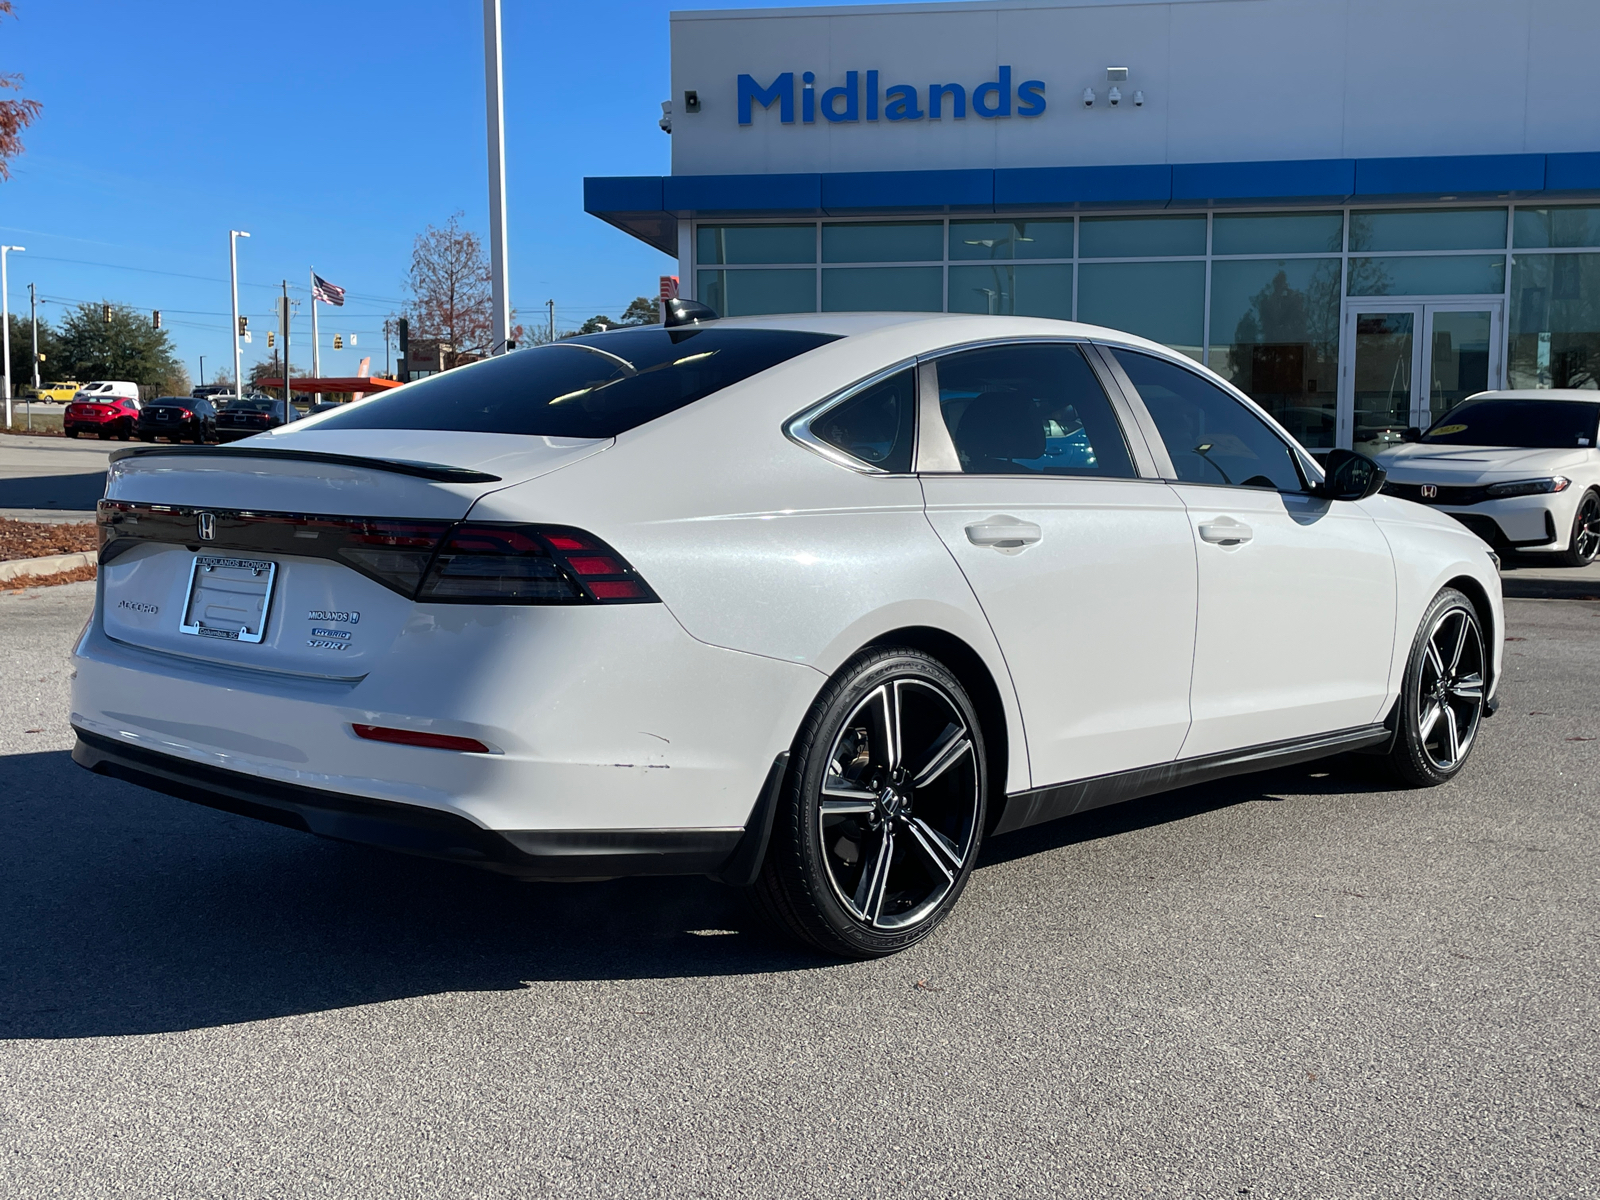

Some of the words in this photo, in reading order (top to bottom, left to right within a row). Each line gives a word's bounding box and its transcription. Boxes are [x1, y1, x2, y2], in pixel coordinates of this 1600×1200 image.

[737, 65, 1047, 126] Midlands
[202, 558, 240, 567] MIDLANDS
[117, 600, 159, 615] ACCORD
[308, 610, 349, 622] MIDLANDS
[315, 629, 349, 639] HYBRID
[306, 639, 352, 651] SPORT
